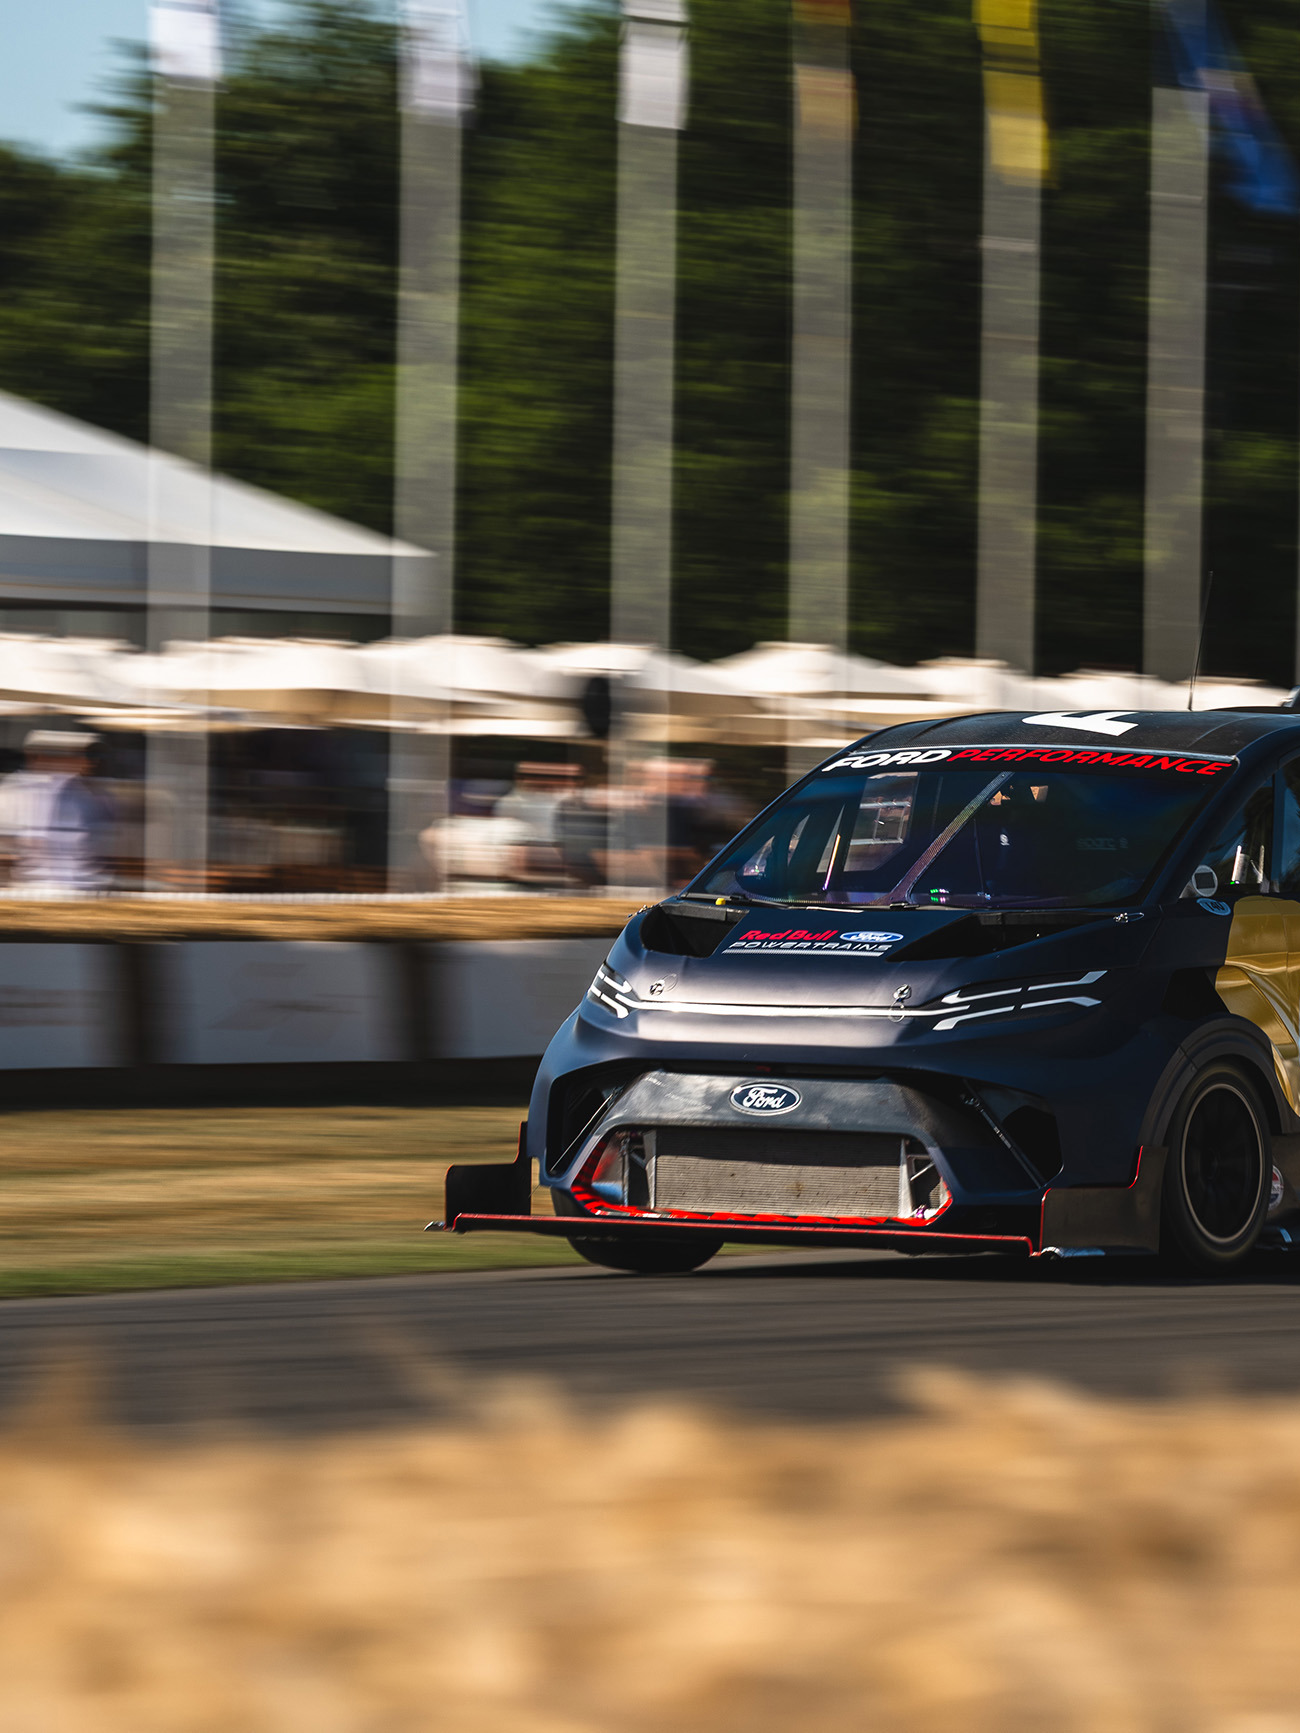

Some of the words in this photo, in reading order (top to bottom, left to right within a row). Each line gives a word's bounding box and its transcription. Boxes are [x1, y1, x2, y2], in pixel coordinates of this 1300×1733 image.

[822, 749, 952, 772] FORD
[946, 748, 1232, 776] PERFORMANCE
[738, 930, 793, 941] Red
[786, 929, 838, 941] Bull
[729, 941, 893, 951] POWERTRAINS
[743, 1088, 788, 1109] Ford
